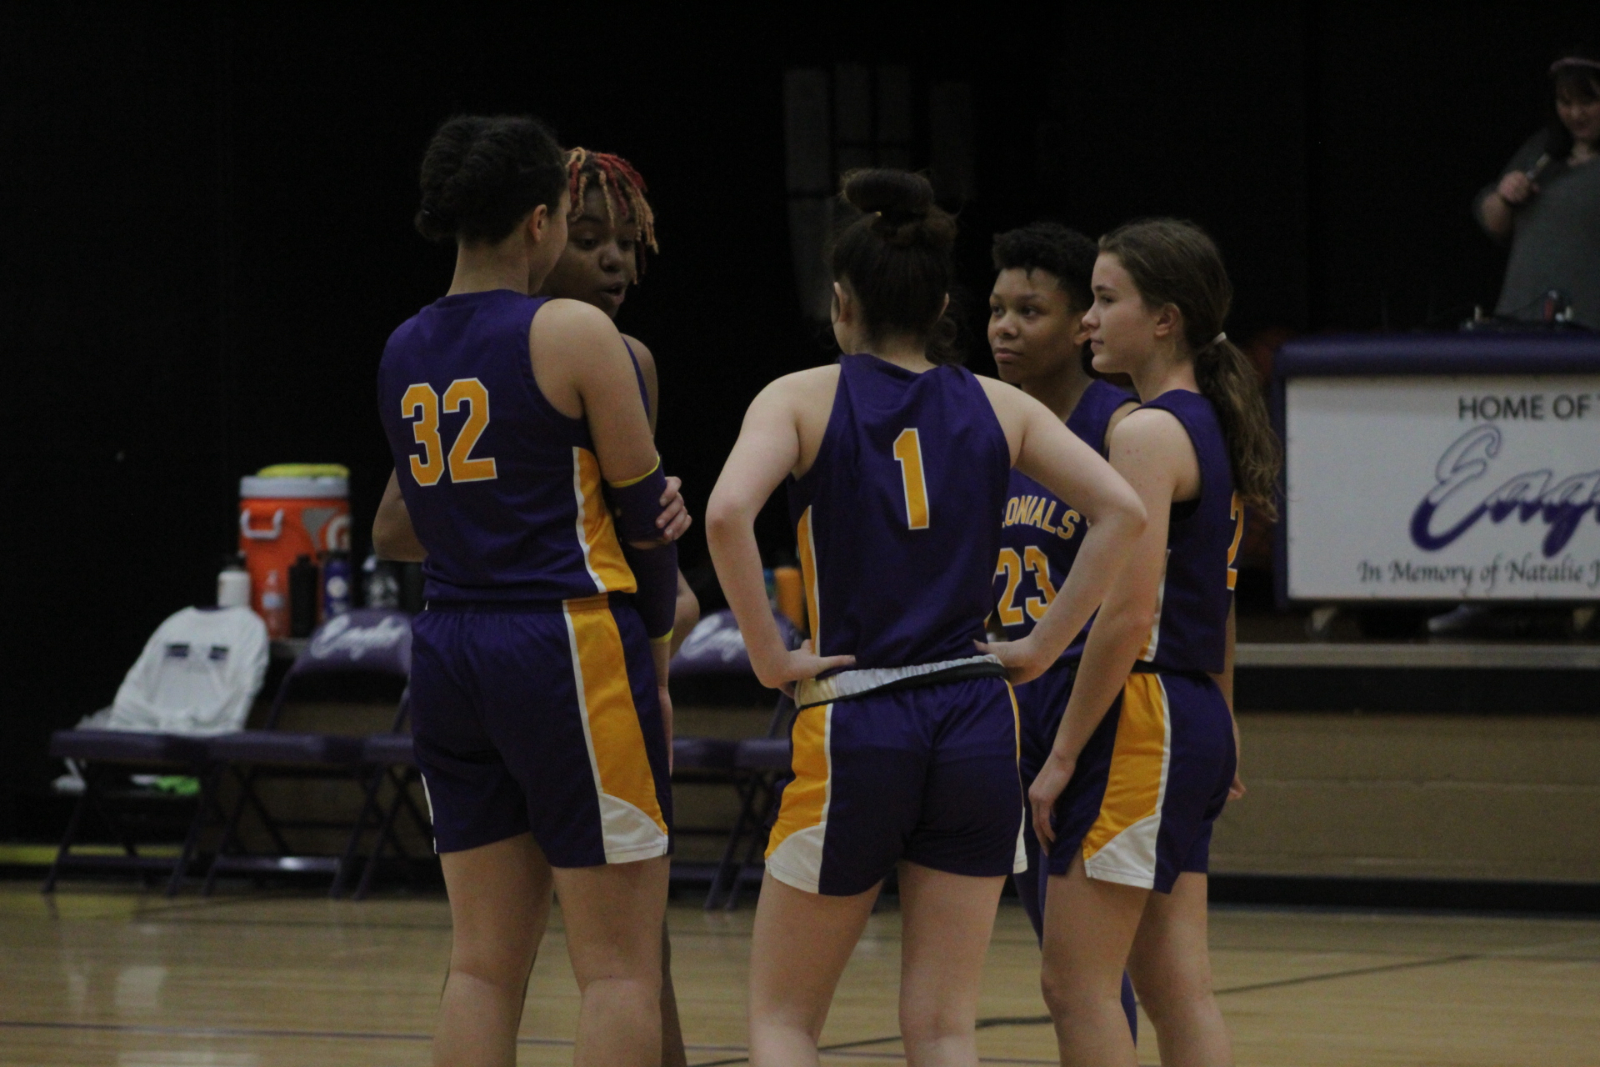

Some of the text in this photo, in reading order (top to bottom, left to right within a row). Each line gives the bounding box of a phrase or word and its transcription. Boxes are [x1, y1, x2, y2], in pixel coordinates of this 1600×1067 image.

[401, 377, 498, 487] 32
[1458, 393, 1591, 421] HOME OF
[893, 427, 930, 530] 1
[1002, 494, 1081, 540] ONIALS
[1411, 423, 1600, 558] Eag
[996, 545, 1058, 627] 23
[1357, 560, 1382, 583] In
[1388, 559, 1474, 596] Memory
[1479, 552, 1503, 592] of
[1503, 551, 1584, 583] Natalie
